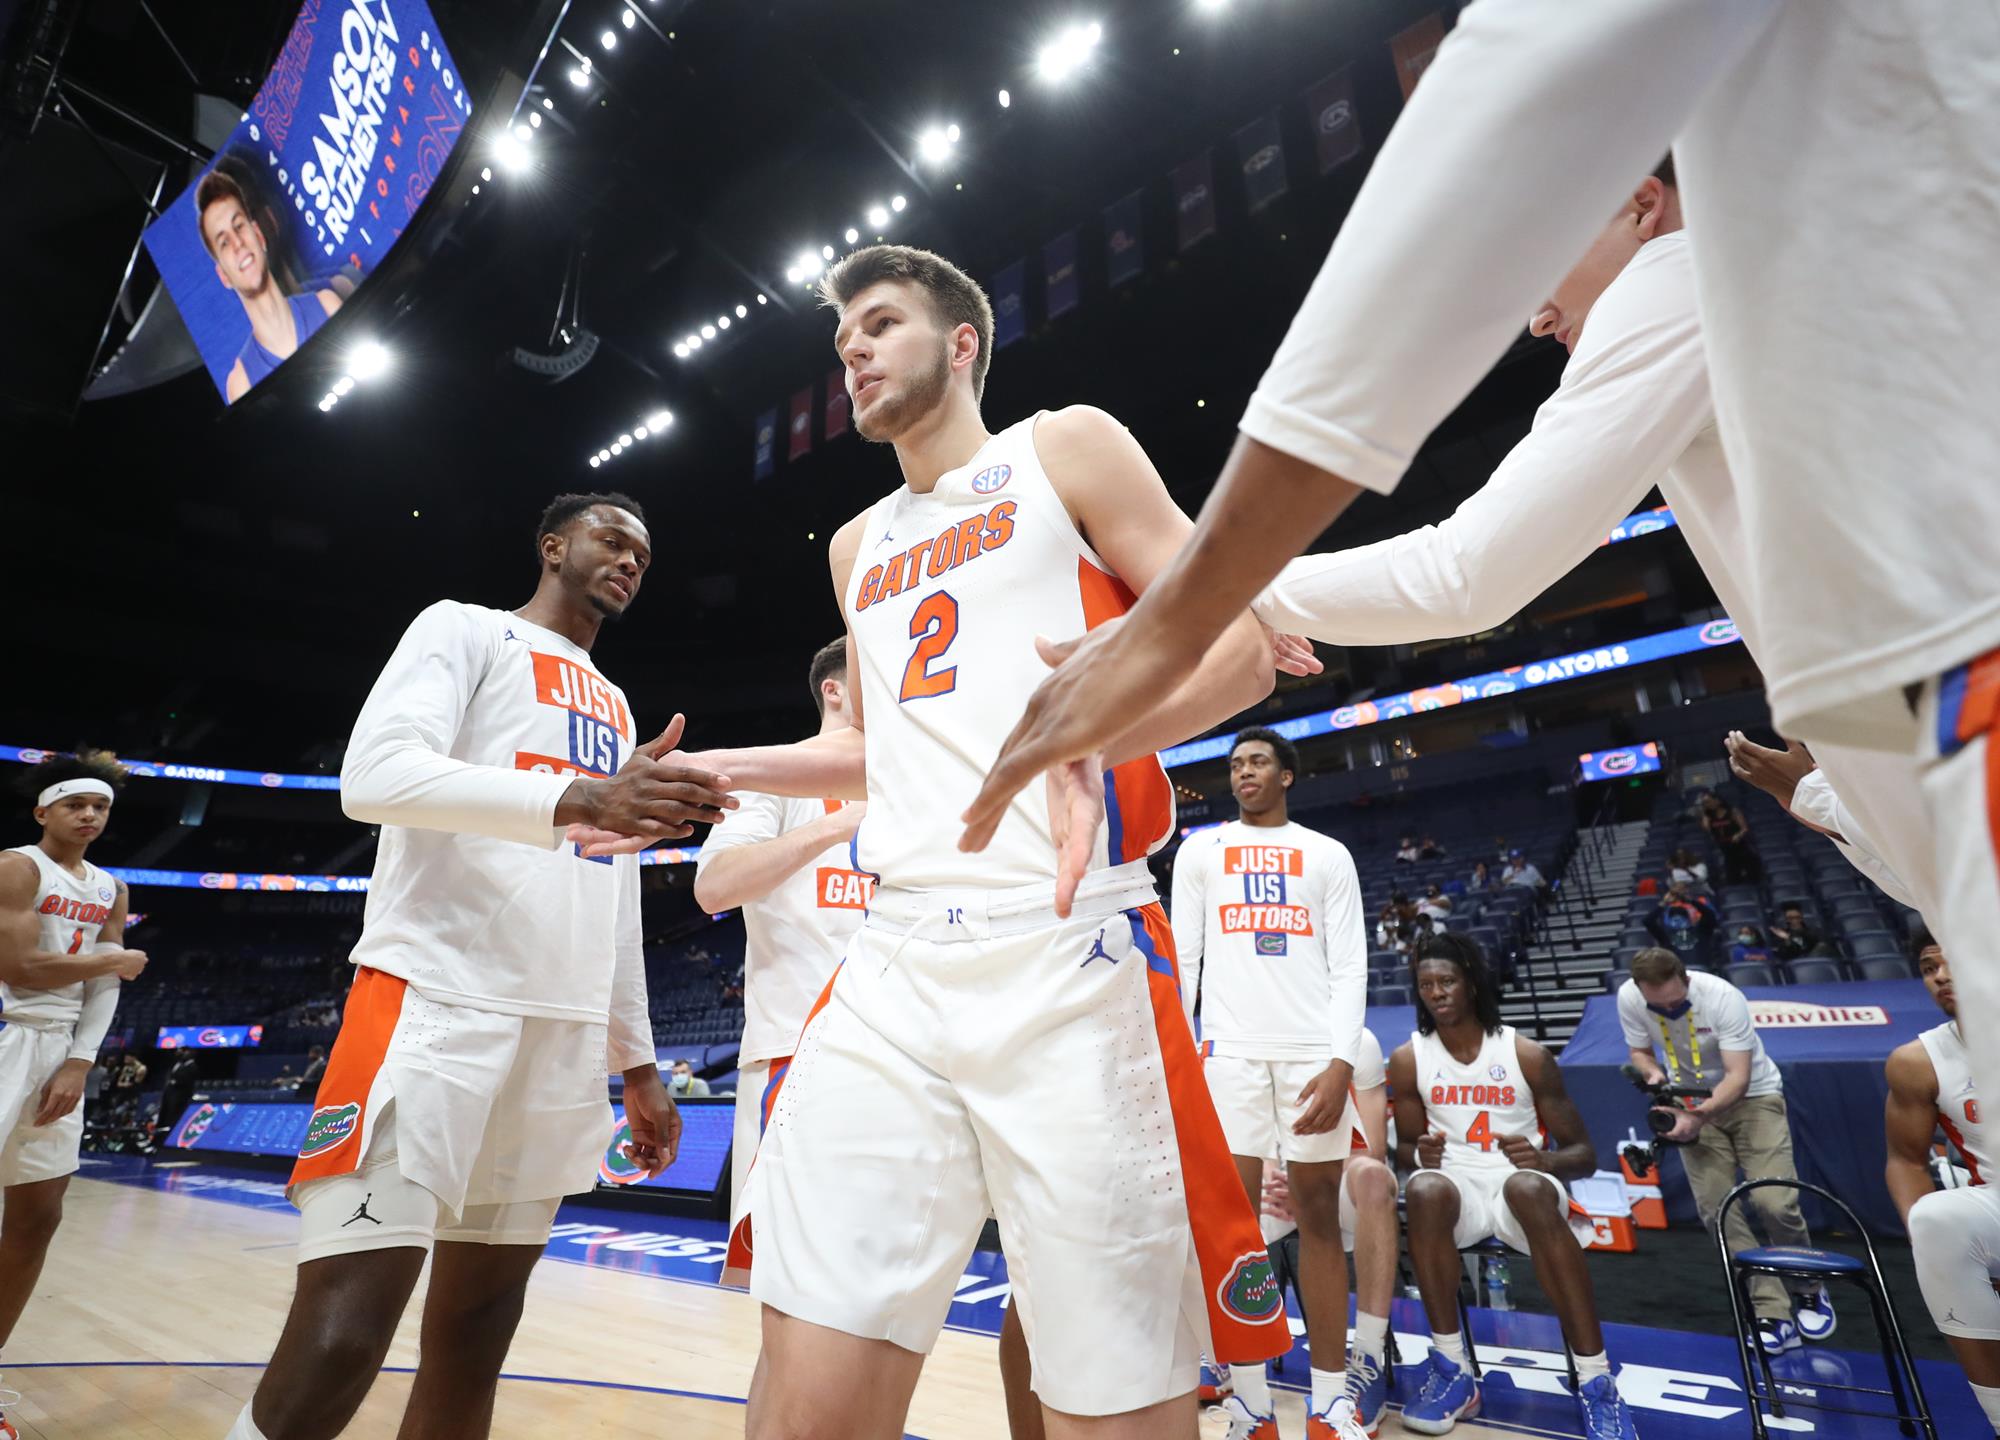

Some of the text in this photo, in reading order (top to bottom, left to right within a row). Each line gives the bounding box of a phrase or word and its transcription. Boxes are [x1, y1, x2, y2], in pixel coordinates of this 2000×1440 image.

[324, 0, 400, 245] RUZHENTSEV
[369, 47, 421, 221] FORWARD
[975, 465, 1010, 492] SEC
[855, 500, 1018, 612] GATORS
[899, 589, 959, 704] 2
[1524, 645, 1629, 684] GATORS
[550, 661, 622, 731] JUST
[576, 715, 614, 773] US
[164, 765, 226, 783] GATORS
[1232, 848, 1295, 873] JUST
[825, 873, 876, 905] GAT
[1249, 875, 1281, 903] US
[1225, 907, 1308, 931] GATORS
[67, 928, 84, 954] 1
[1754, 1009, 1875, 1024] onville
[1431, 1085, 1516, 1106] GATORS
[1466, 1111, 1494, 1152] 4
